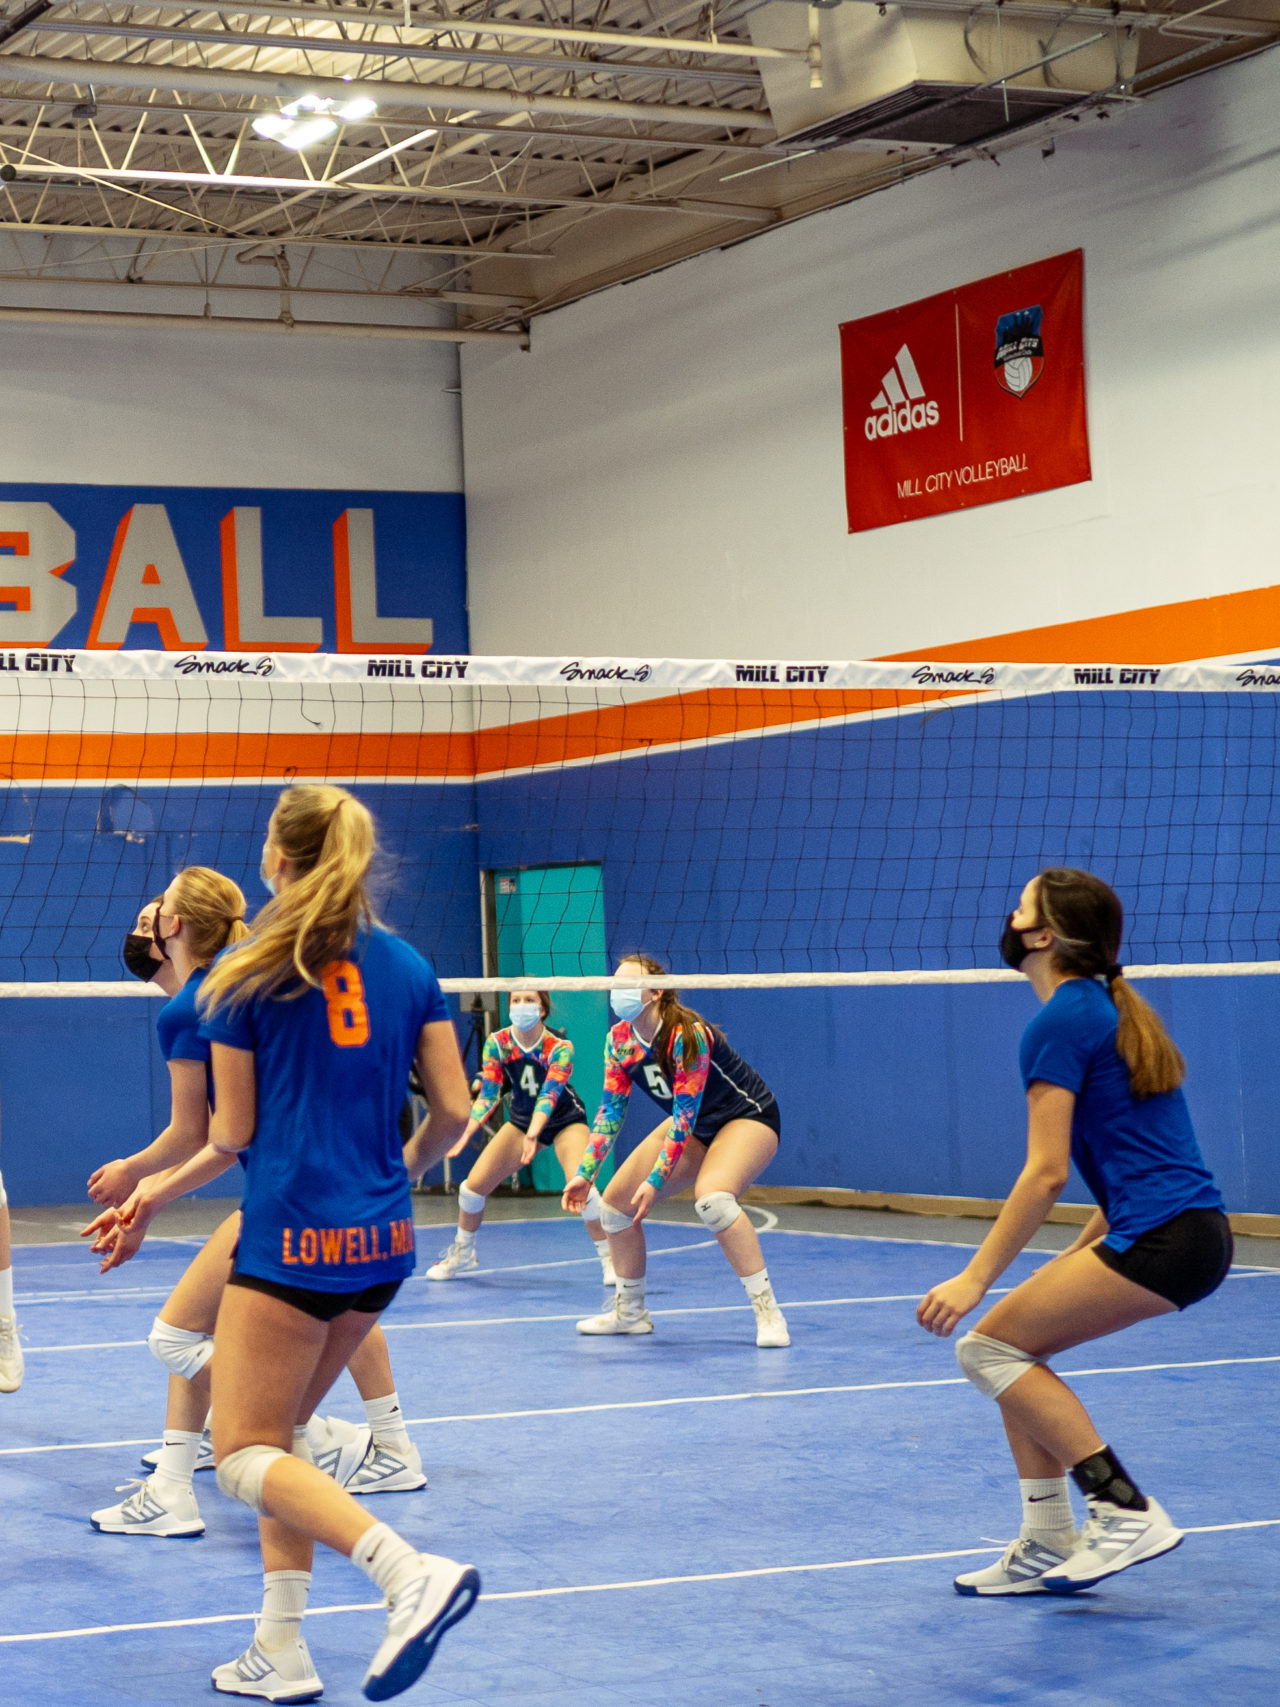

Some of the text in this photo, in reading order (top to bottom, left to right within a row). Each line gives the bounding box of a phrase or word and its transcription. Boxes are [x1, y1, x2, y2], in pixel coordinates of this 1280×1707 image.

[865, 400, 939, 441] adidas
[897, 453, 1028, 499] MILL CITY VOLLEYBALL
[25, 653, 76, 672] CITY
[367, 660, 469, 678] MILL CITY
[735, 665, 829, 682] MILL CITY
[1073, 668, 1160, 684] MILL CITY
[322, 960, 370, 1048] 8
[520, 1065, 539, 1097] 4
[643, 1063, 673, 1099] 5
